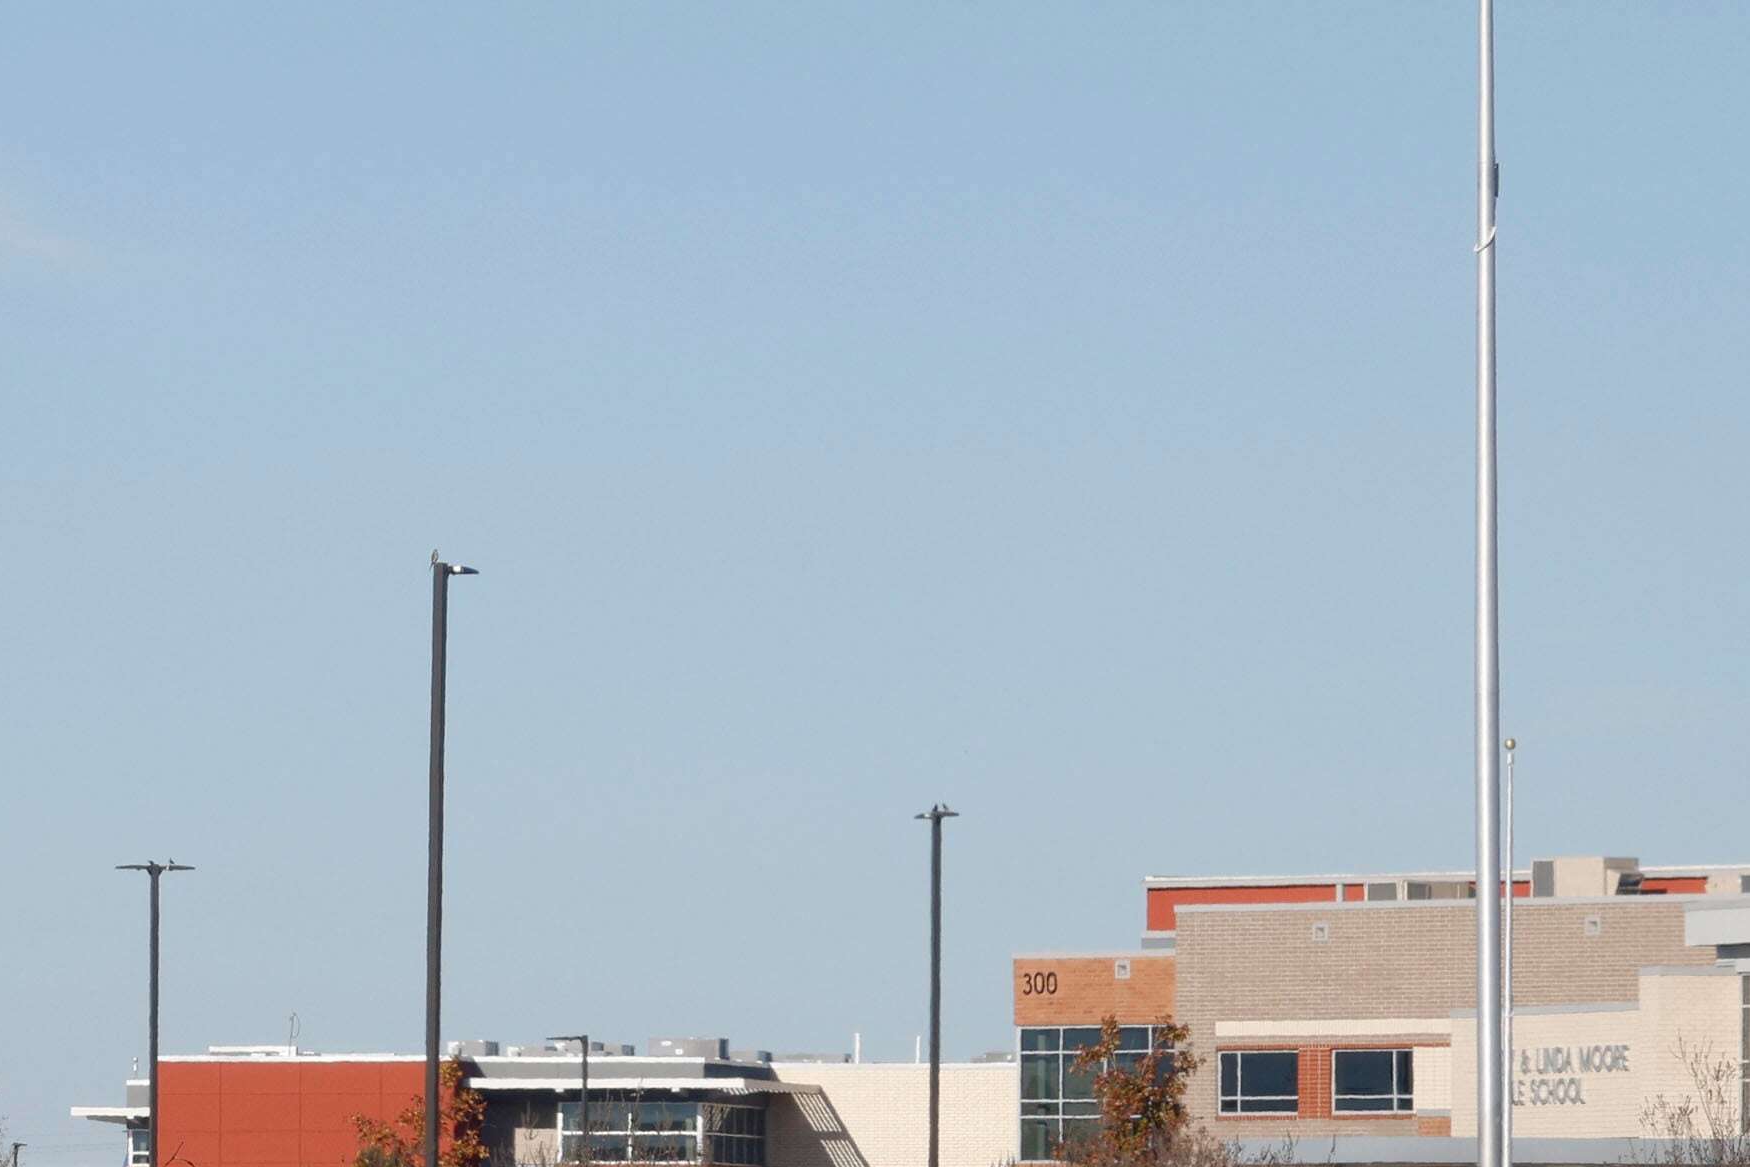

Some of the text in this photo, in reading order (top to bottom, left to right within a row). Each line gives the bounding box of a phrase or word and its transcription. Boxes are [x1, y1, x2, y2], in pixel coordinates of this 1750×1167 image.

[1023, 972, 1057, 995] 300
[1536, 1046, 1575, 1075] LINDA
[1578, 1044, 1630, 1073] MOORE
[1530, 1077, 1586, 1106] SCHOOL
